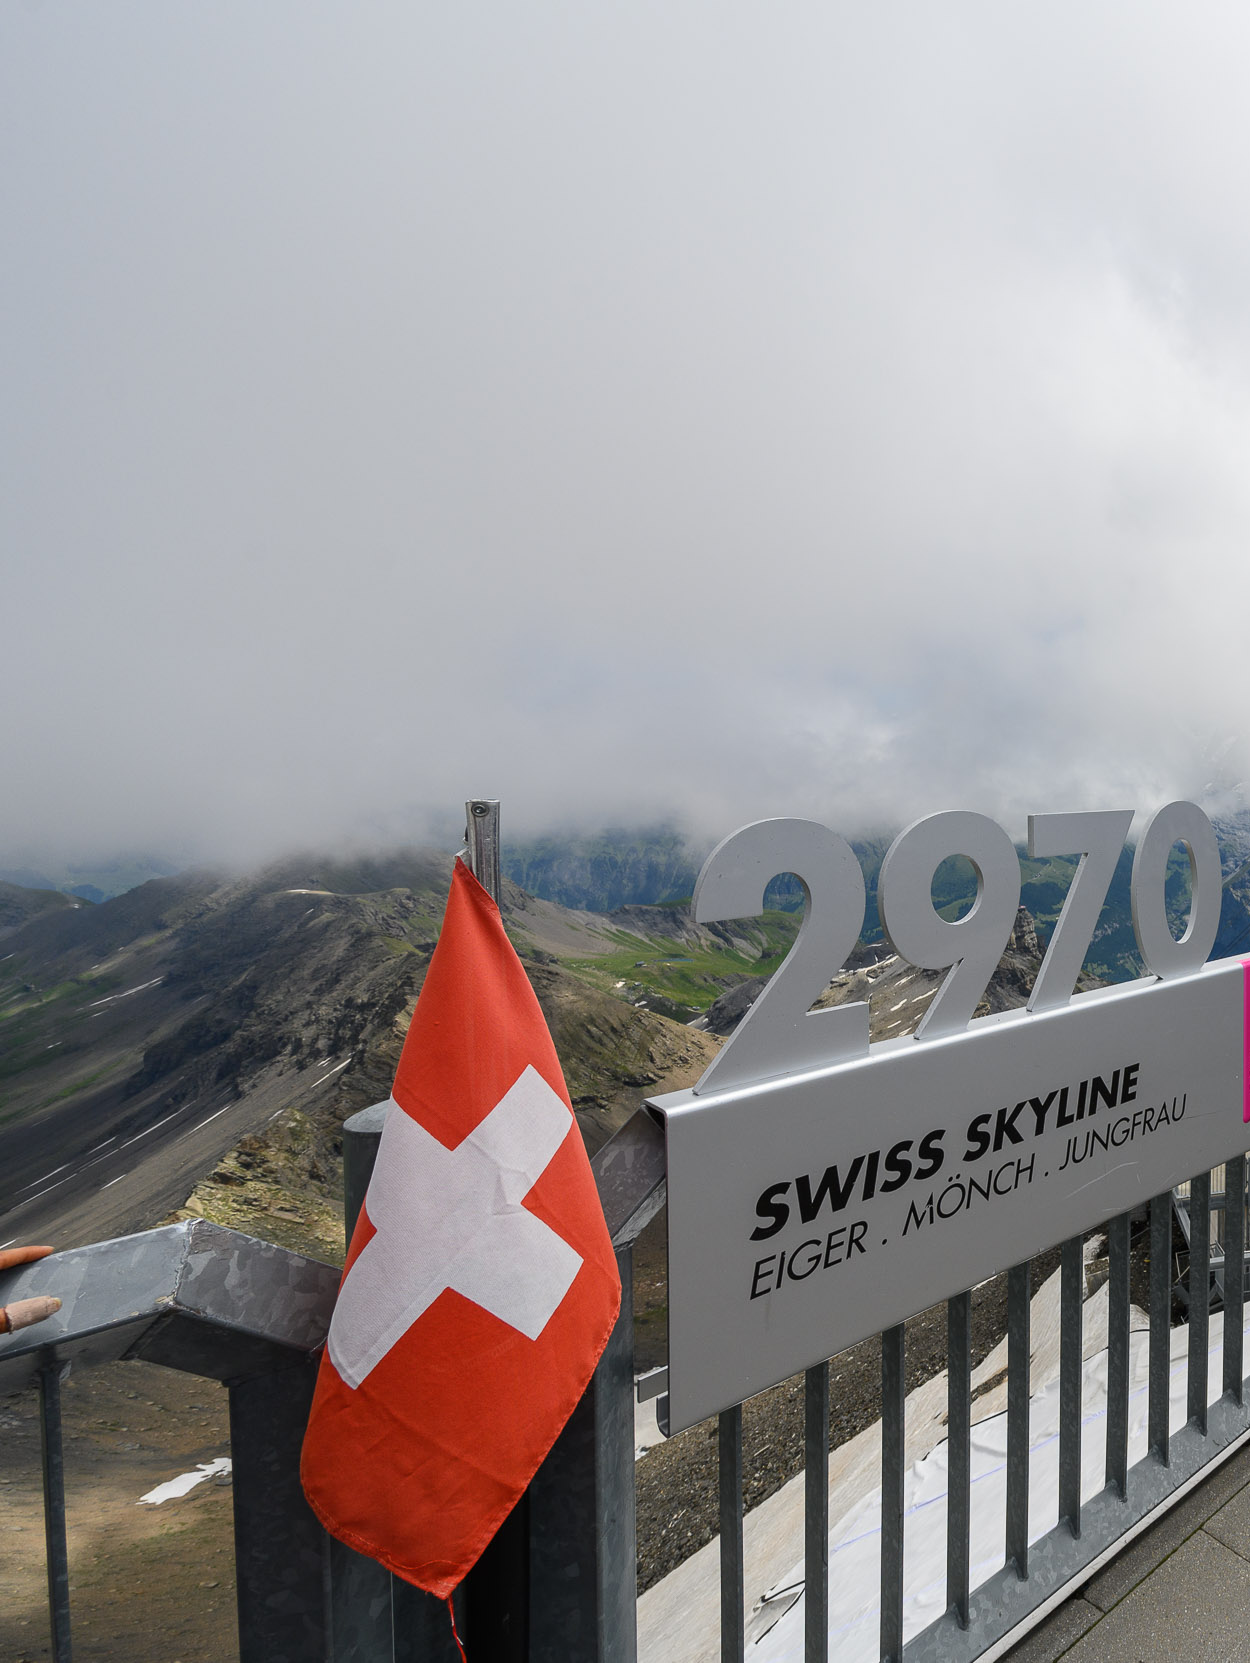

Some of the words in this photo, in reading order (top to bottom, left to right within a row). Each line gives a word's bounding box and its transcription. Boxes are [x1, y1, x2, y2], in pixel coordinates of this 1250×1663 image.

[692, 800, 1223, 1096] 2970
[749, 1129, 947, 1241] SWISS
[962, 1062, 1140, 1162] SKYLINE
[750, 1220, 868, 1300] EIGER
[902, 1152, 1035, 1237] MÖNCH
[1058, 1093, 1187, 1171] JUNGFRAU
